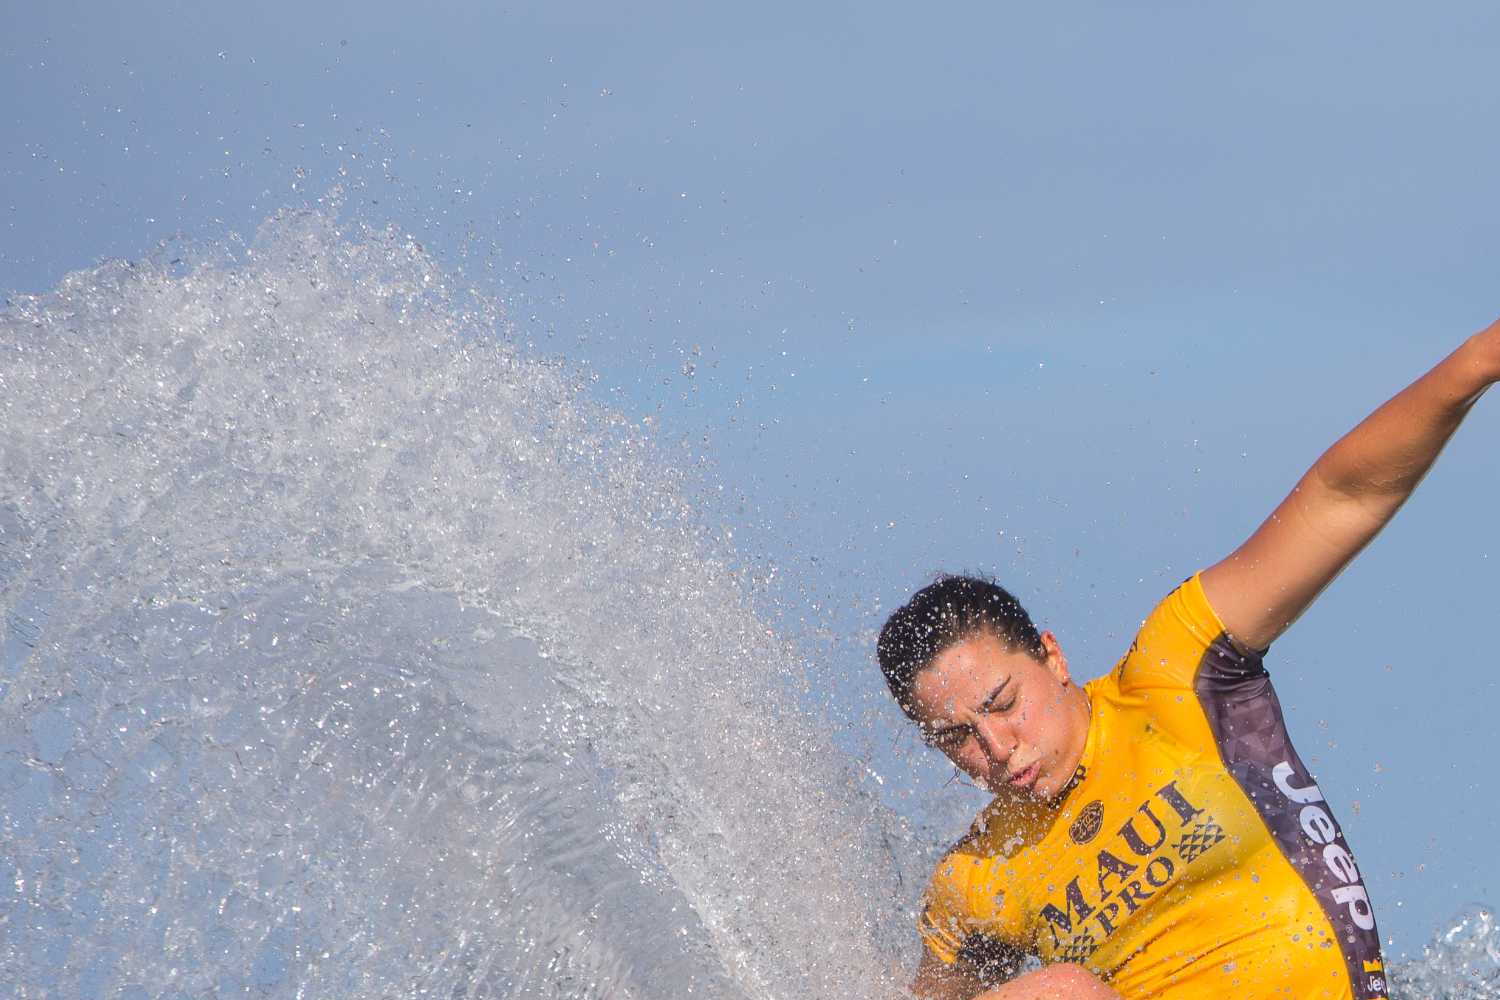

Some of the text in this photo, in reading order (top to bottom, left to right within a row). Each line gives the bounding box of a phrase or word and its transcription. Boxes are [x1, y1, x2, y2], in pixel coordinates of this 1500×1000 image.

[1040, 780, 1205, 950] MAUI
[1095, 856, 1175, 937] PRO
[1272, 761, 1375, 931] Jeep
